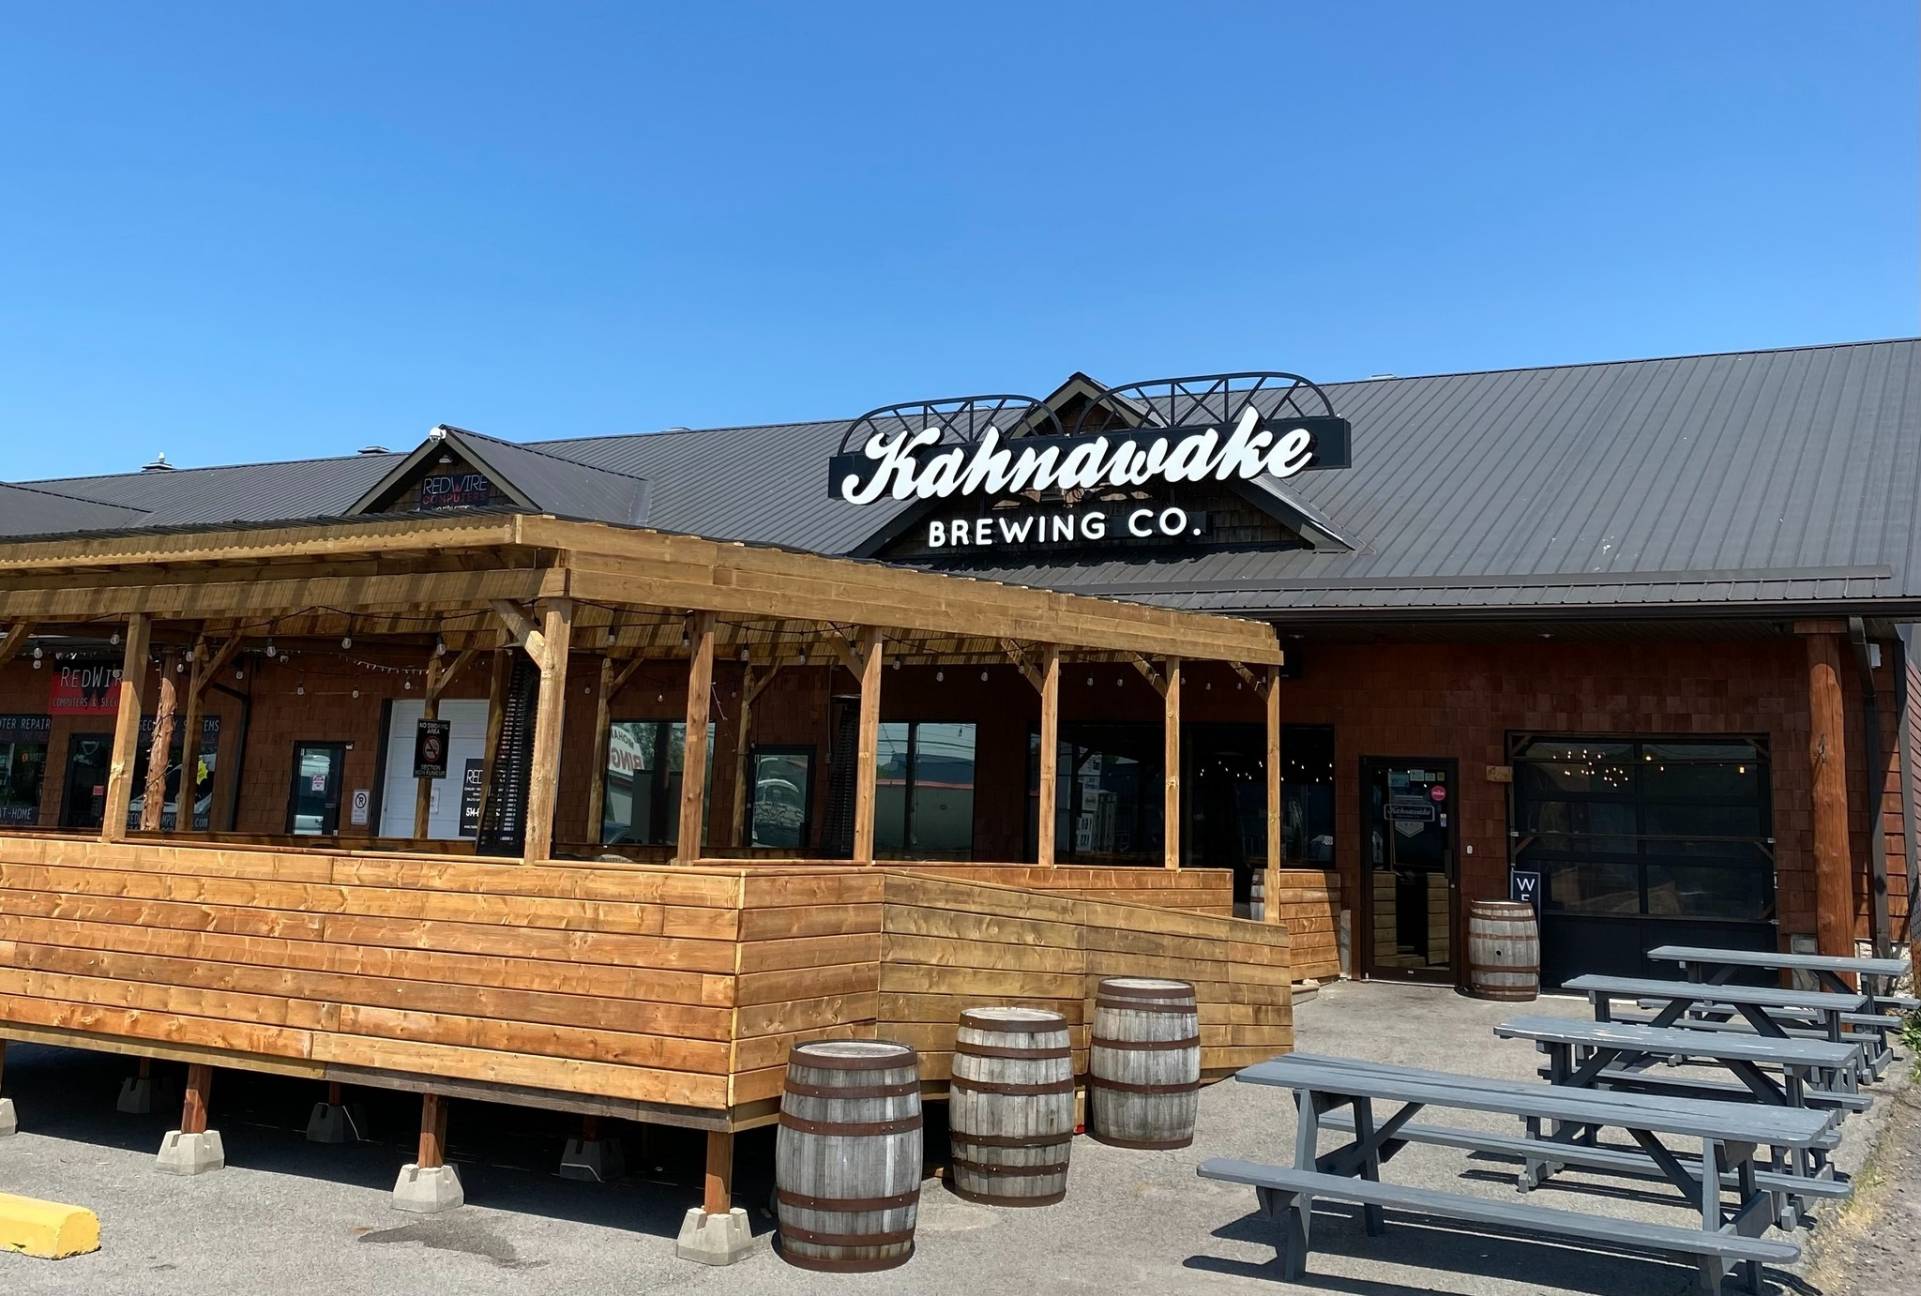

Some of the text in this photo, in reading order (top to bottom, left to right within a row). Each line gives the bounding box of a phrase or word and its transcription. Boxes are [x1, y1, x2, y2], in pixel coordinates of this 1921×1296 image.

[840, 406, 1314, 506] Kahnawake
[423, 475, 487, 494] REDWIRE
[927, 506, 1202, 548] BREWING CO.
